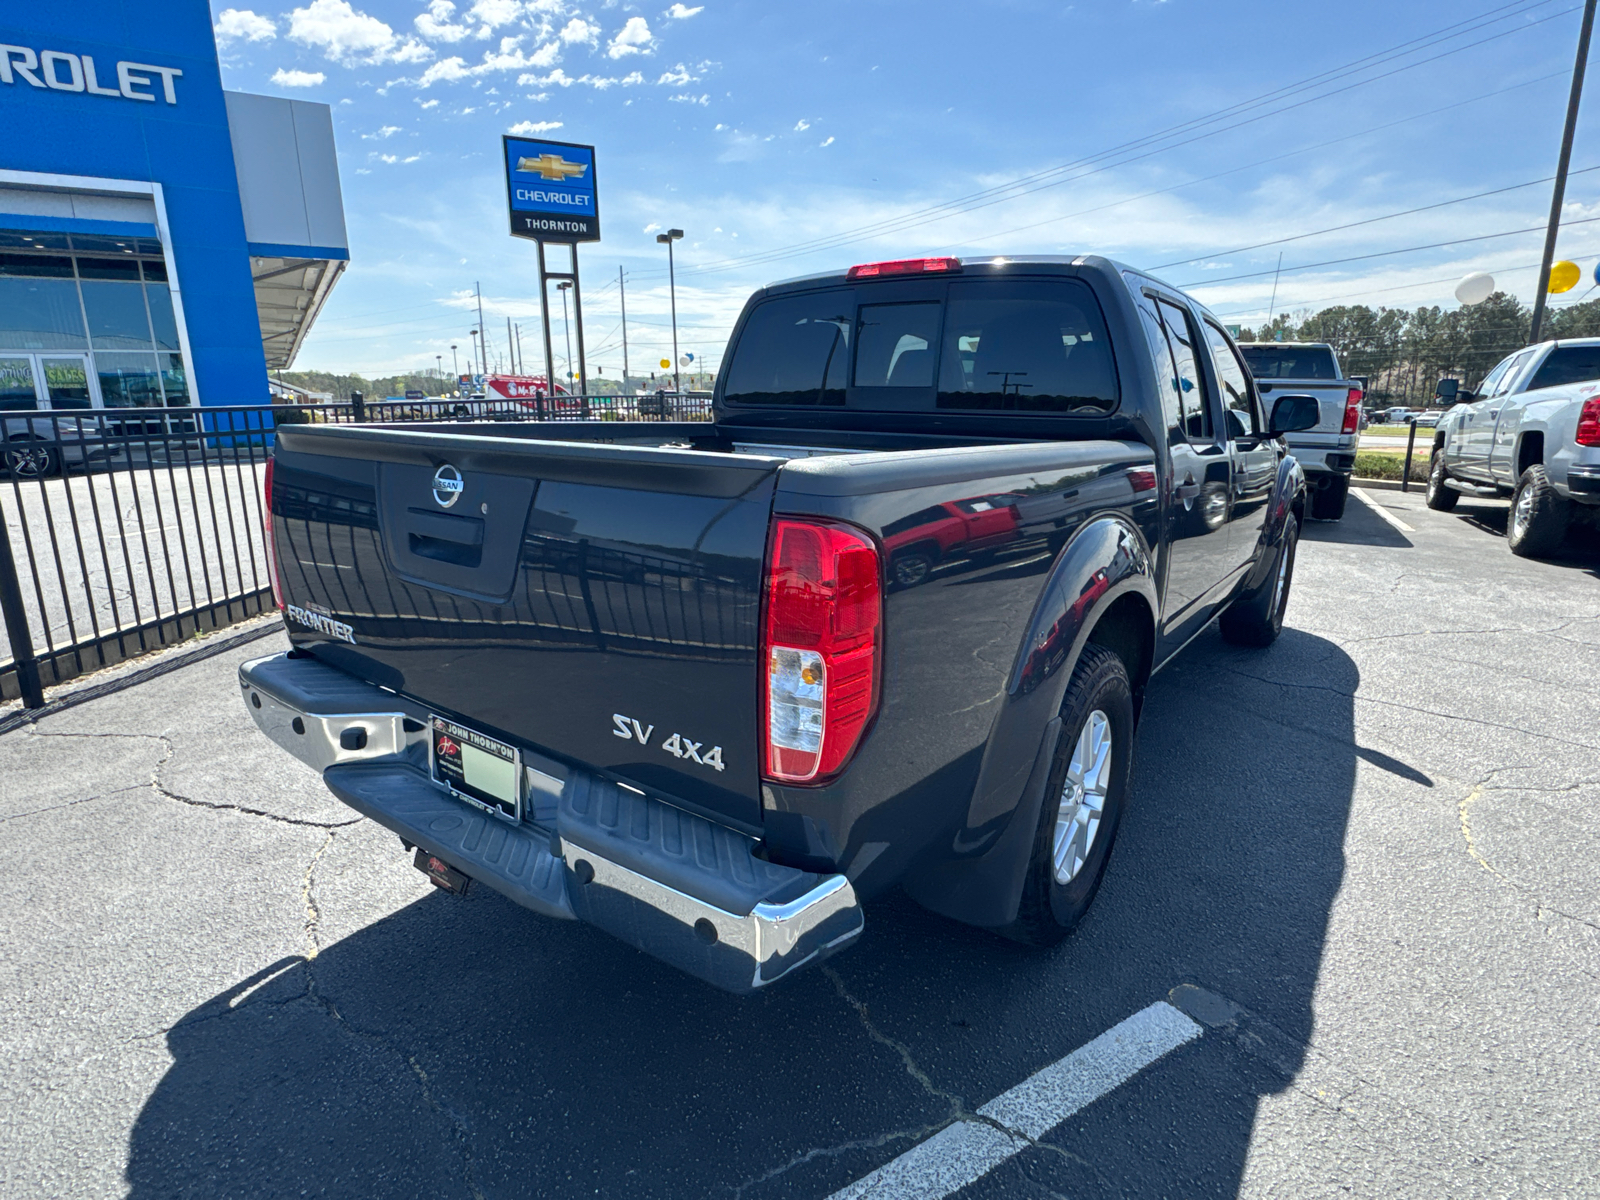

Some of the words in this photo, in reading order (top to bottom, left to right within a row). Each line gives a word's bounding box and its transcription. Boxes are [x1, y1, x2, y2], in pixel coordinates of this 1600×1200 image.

[516, 189, 590, 206] CHEVROLET
[525, 218, 587, 232] THORNTON
[48, 369, 85, 383] SALES
[433, 480, 459, 490] NISSAN
[287, 604, 357, 645] FRONTIER
[612, 713, 655, 745] SV
[448, 723, 468, 740] JOHN
[469, 732, 513, 759] THORNTON
[459, 794, 485, 811] CHEVROLET
